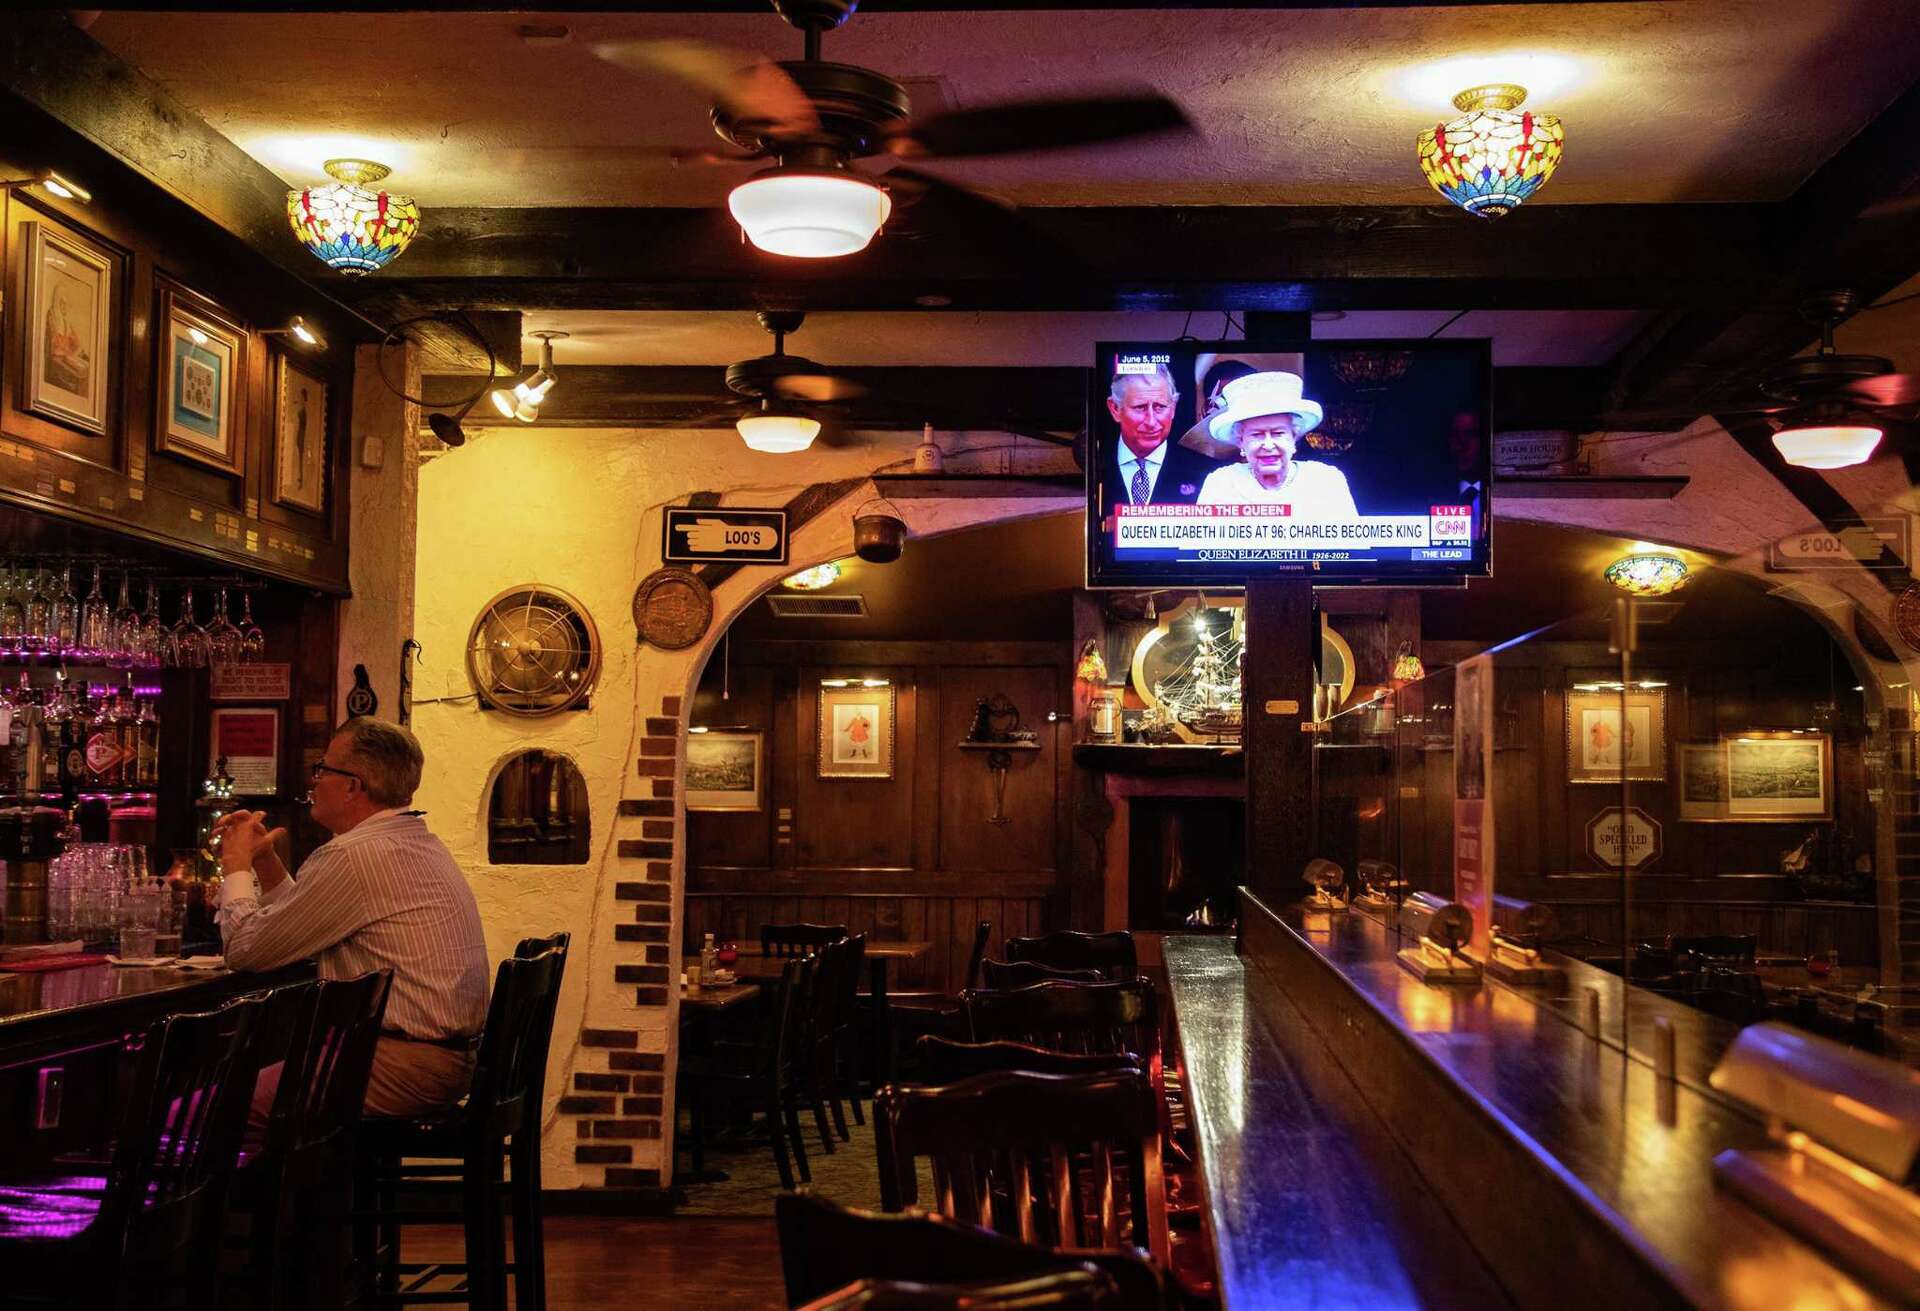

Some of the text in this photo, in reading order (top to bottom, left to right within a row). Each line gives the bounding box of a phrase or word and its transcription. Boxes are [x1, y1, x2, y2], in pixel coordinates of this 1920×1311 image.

[1122, 354, 1141, 363] June
[1151, 354, 1171, 364] 2012
[1121, 505, 1285, 516] REMEMBERING THE QUEEN
[1436, 506, 1466, 515] LIVE
[1121, 525, 1157, 539] QUEEN
[1159, 525, 1216, 539] ELIZABETH
[1219, 525, 1226, 538] II
[1228, 525, 1253, 538] DIES
[1255, 525, 1269, 538] AT
[1289, 524, 1338, 538] CHARLES
[1341, 524, 1393, 538] BECOMES
[1396, 524, 1422, 538] KING
[1435, 520, 1466, 535] CNN
[725, 531, 761, 545] LOO'S
[1198, 549, 1237, 560] QUEEN
[1239, 549, 1297, 559] ELIZABETH
[1301, 549, 1308, 559] II
[1422, 551, 1463, 559] THE LEAD
